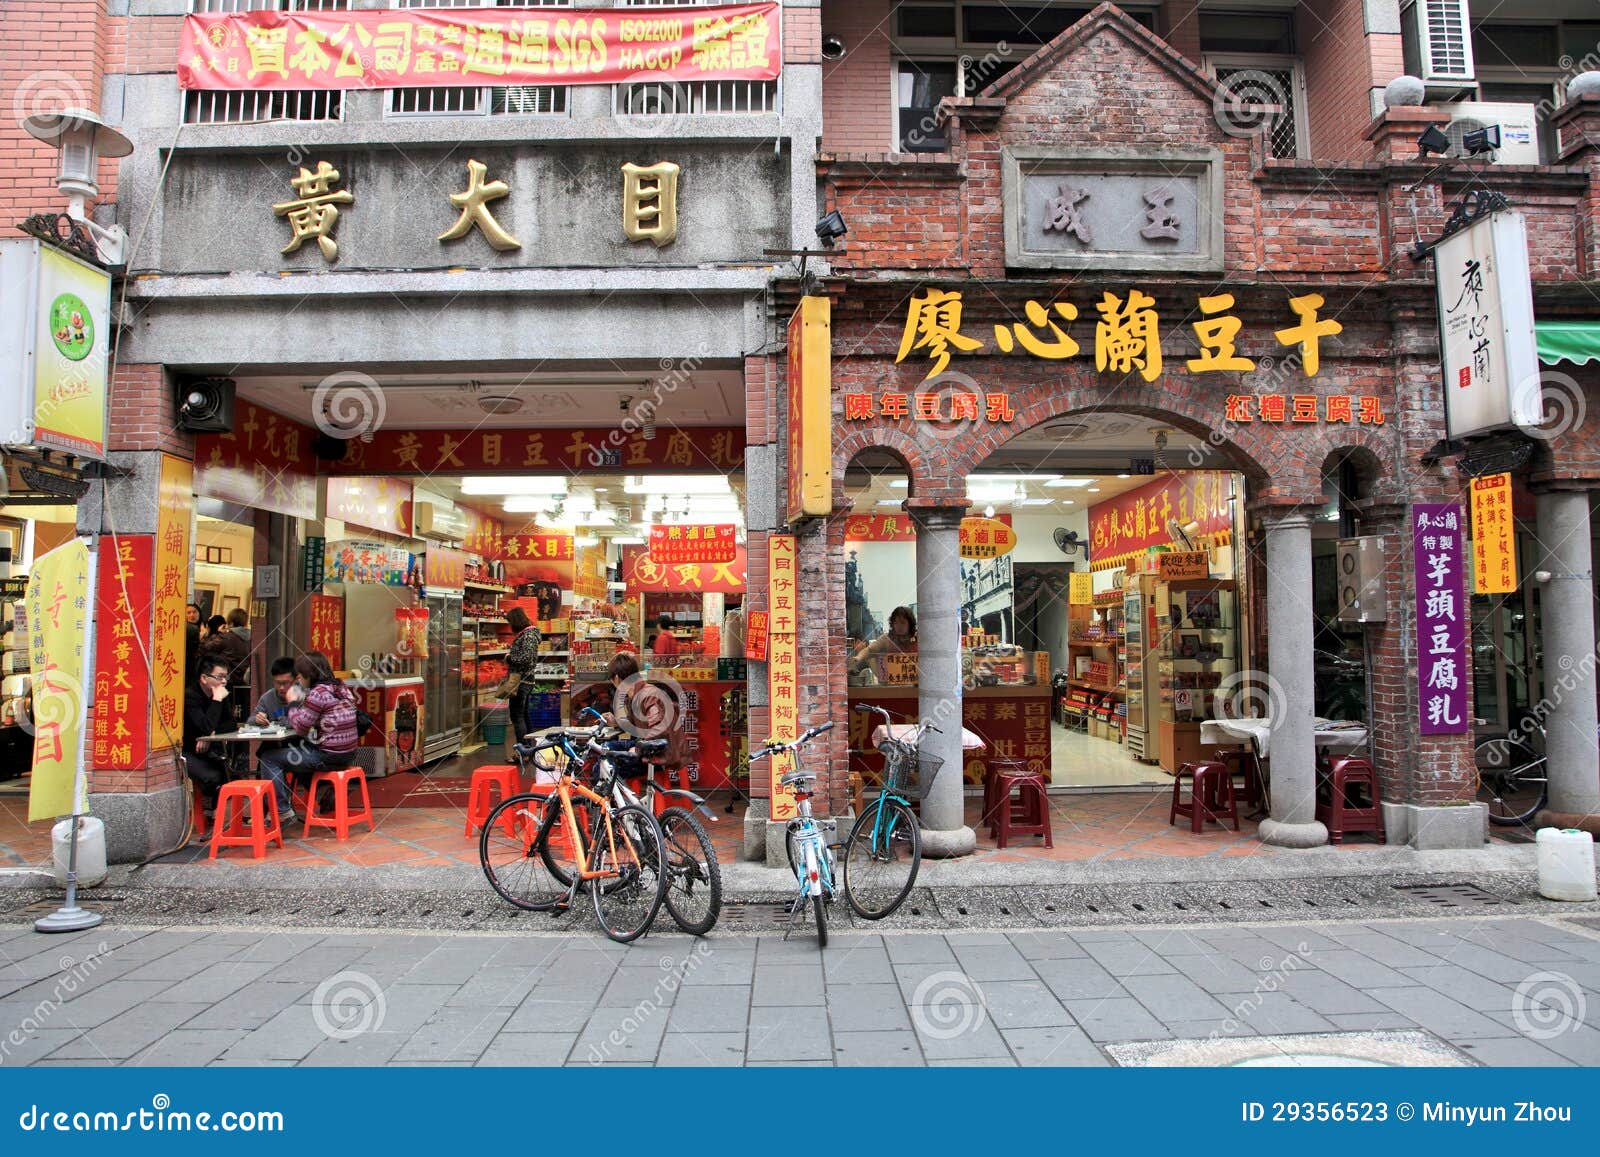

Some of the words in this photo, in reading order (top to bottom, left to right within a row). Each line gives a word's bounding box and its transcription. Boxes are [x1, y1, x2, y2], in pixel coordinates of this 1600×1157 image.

[619, 19, 682, 43] ISO22000
[692, 14, 770, 70] 驗證
[247, 22, 413, 80] 賀本公司
[413, 52, 460, 73] 產品
[617, 47, 682, 70] HACCP
[273, 158, 678, 263] 黃大目
[894, 287, 1343, 382] 廖心蘭豆干
[845, 392, 1015, 422] 陳年豆腐乳
[1225, 394, 1386, 425] 紅糟豆腐乳
[393, 430, 743, 469] 黃大目豆干豆腐乳
[1417, 512, 1458, 532] 廖心蘭
[506, 537, 562, 559] 黃大目
[1423, 535, 1454, 551] 特製
[110, 540, 138, 766] 豆干元祖黃大目本舖
[1424, 553, 1461, 727] 芋頭豆腐乳
